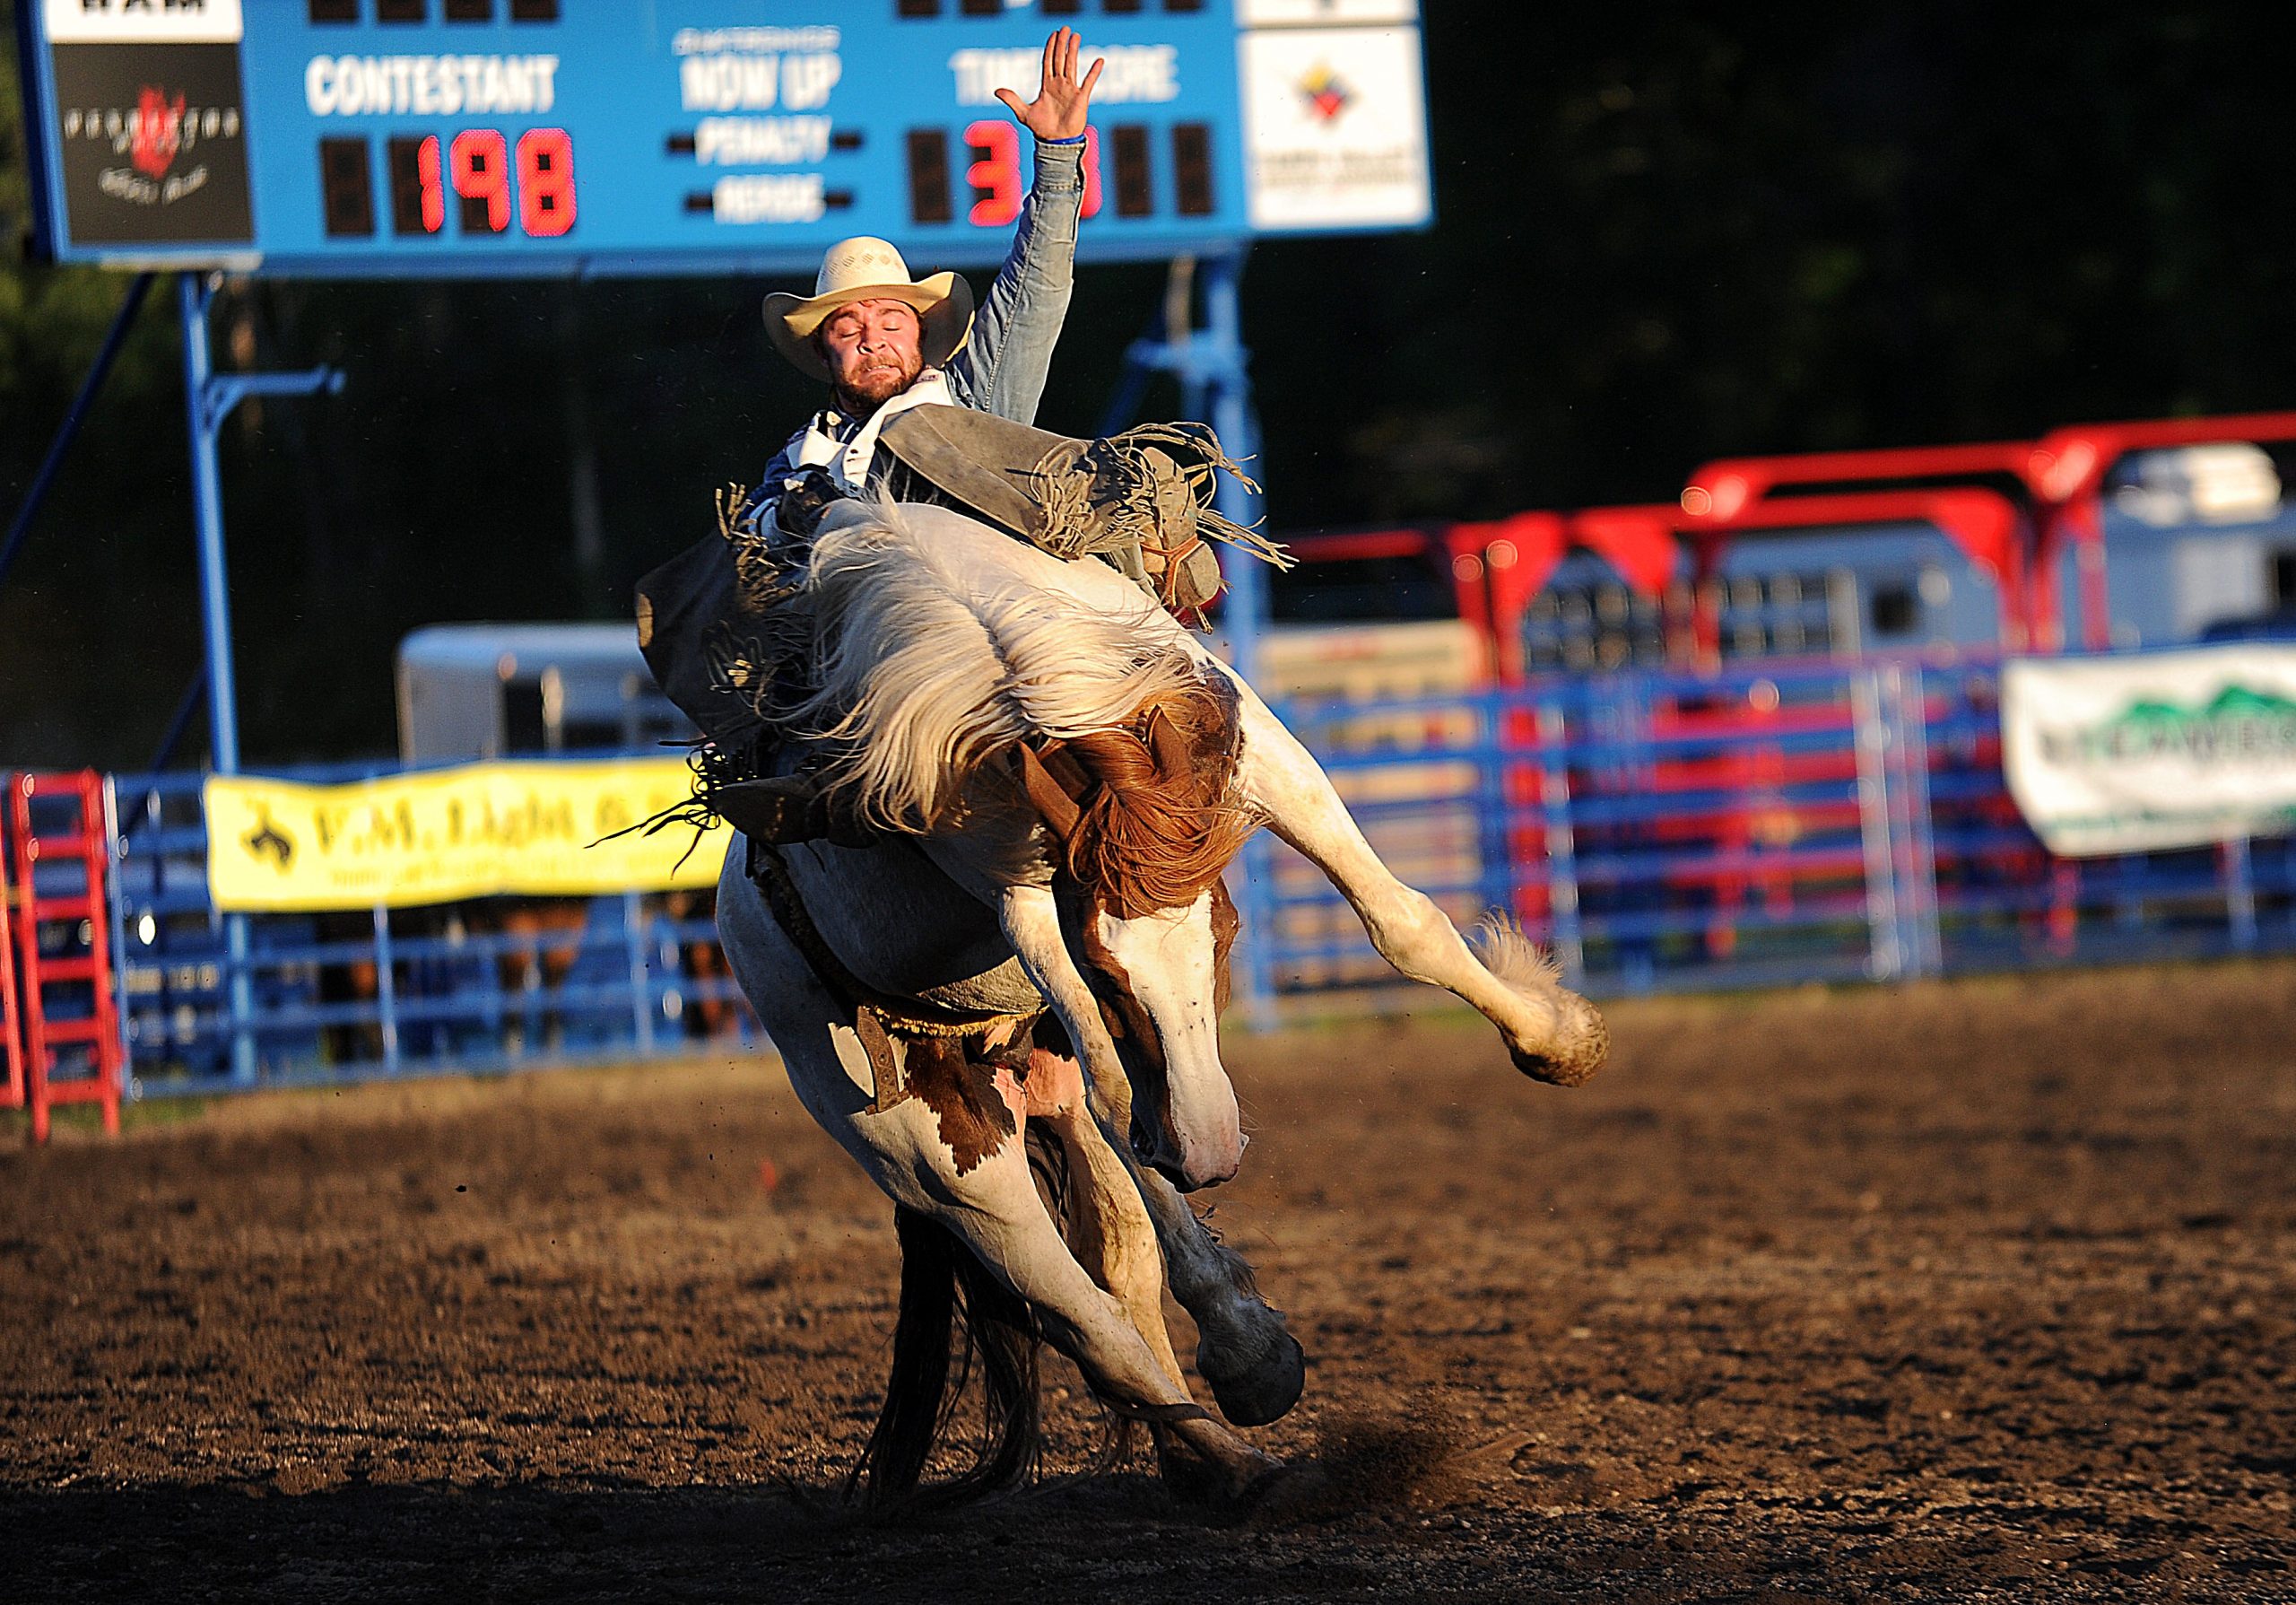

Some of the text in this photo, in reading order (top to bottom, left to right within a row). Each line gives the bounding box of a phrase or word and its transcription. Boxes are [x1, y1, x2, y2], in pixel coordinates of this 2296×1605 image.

[306, 54, 559, 116] CONTESTANT
[681, 53, 841, 111] NOW UP
[695, 115, 832, 165] PENALTY
[417, 128, 577, 237] 198
